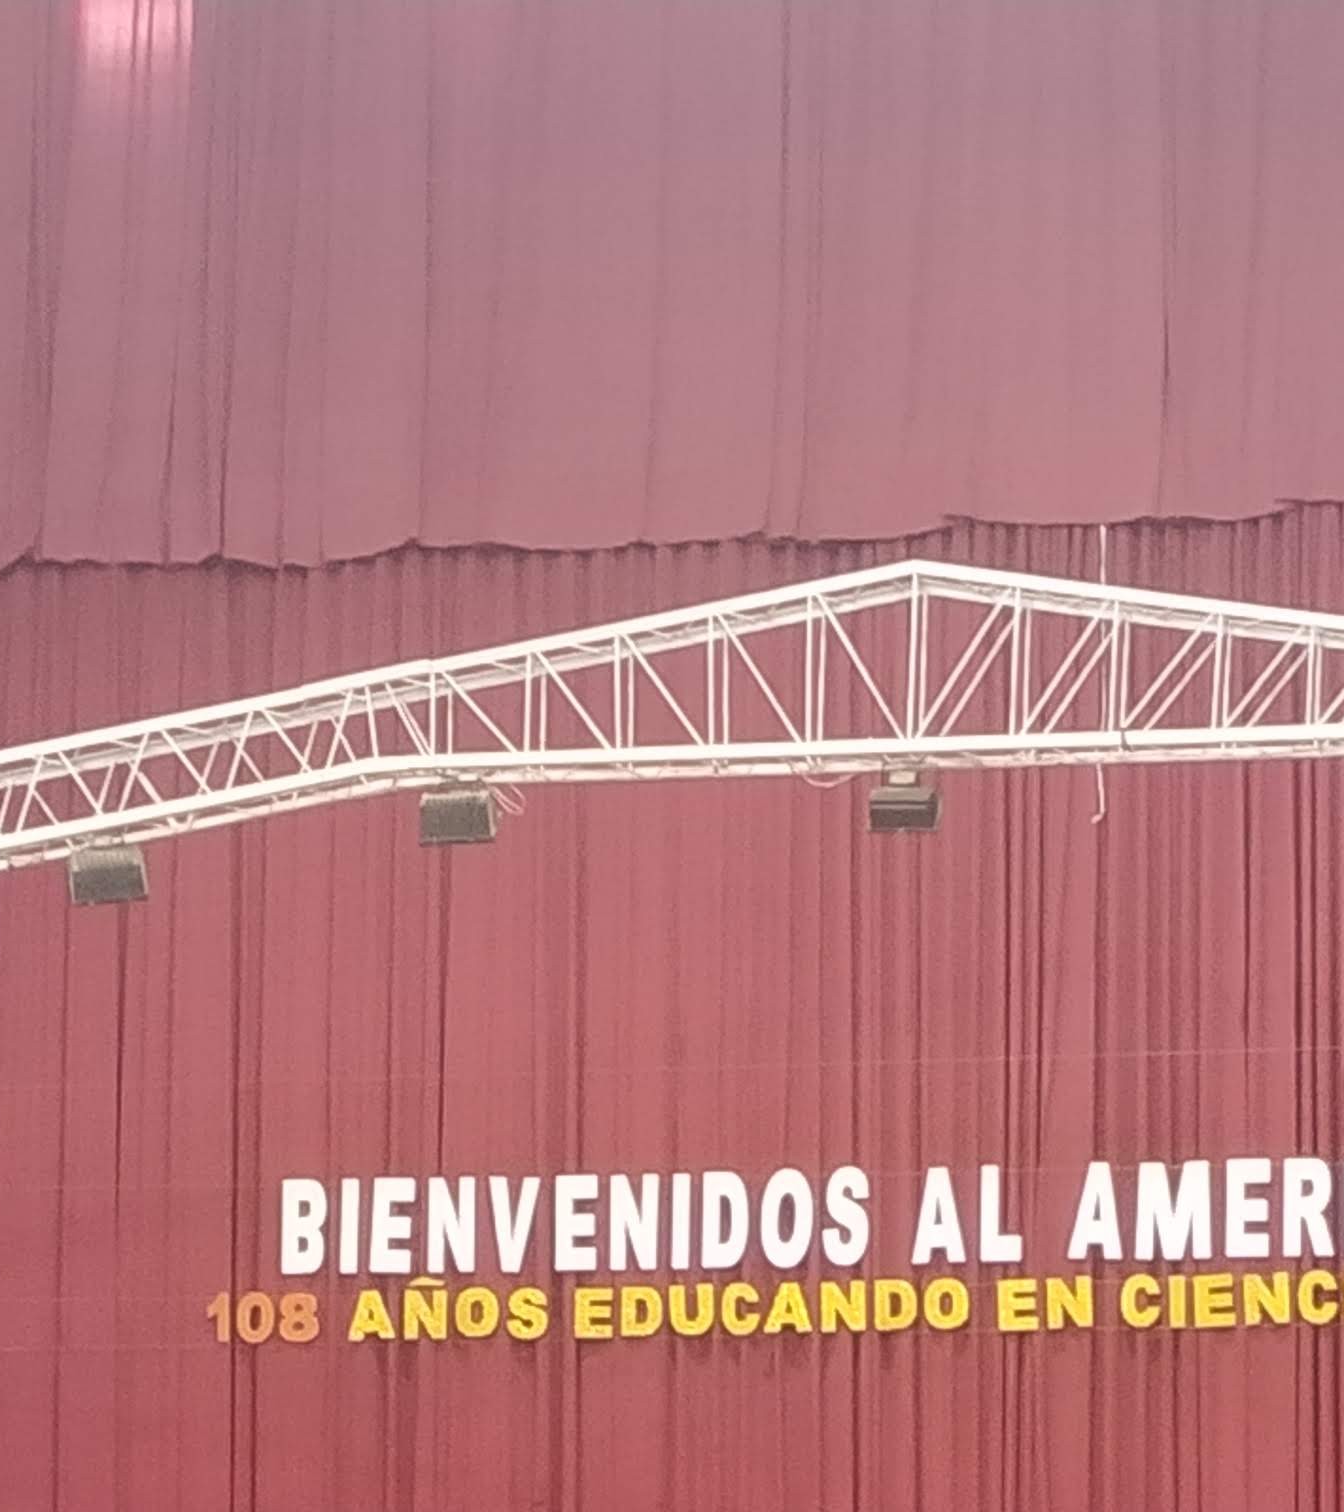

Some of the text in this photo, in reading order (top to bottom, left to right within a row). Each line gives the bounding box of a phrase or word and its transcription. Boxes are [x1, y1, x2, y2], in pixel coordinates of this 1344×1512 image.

[280, 1164, 871, 1276] BIENVENIDOS
[911, 1164, 1024, 1267] AL
[206, 1291, 320, 1343] 108
[347, 1275, 551, 1342] AÑOS
[571, 1275, 973, 1340] EDUCANDO
[994, 1274, 1096, 1333] EN
